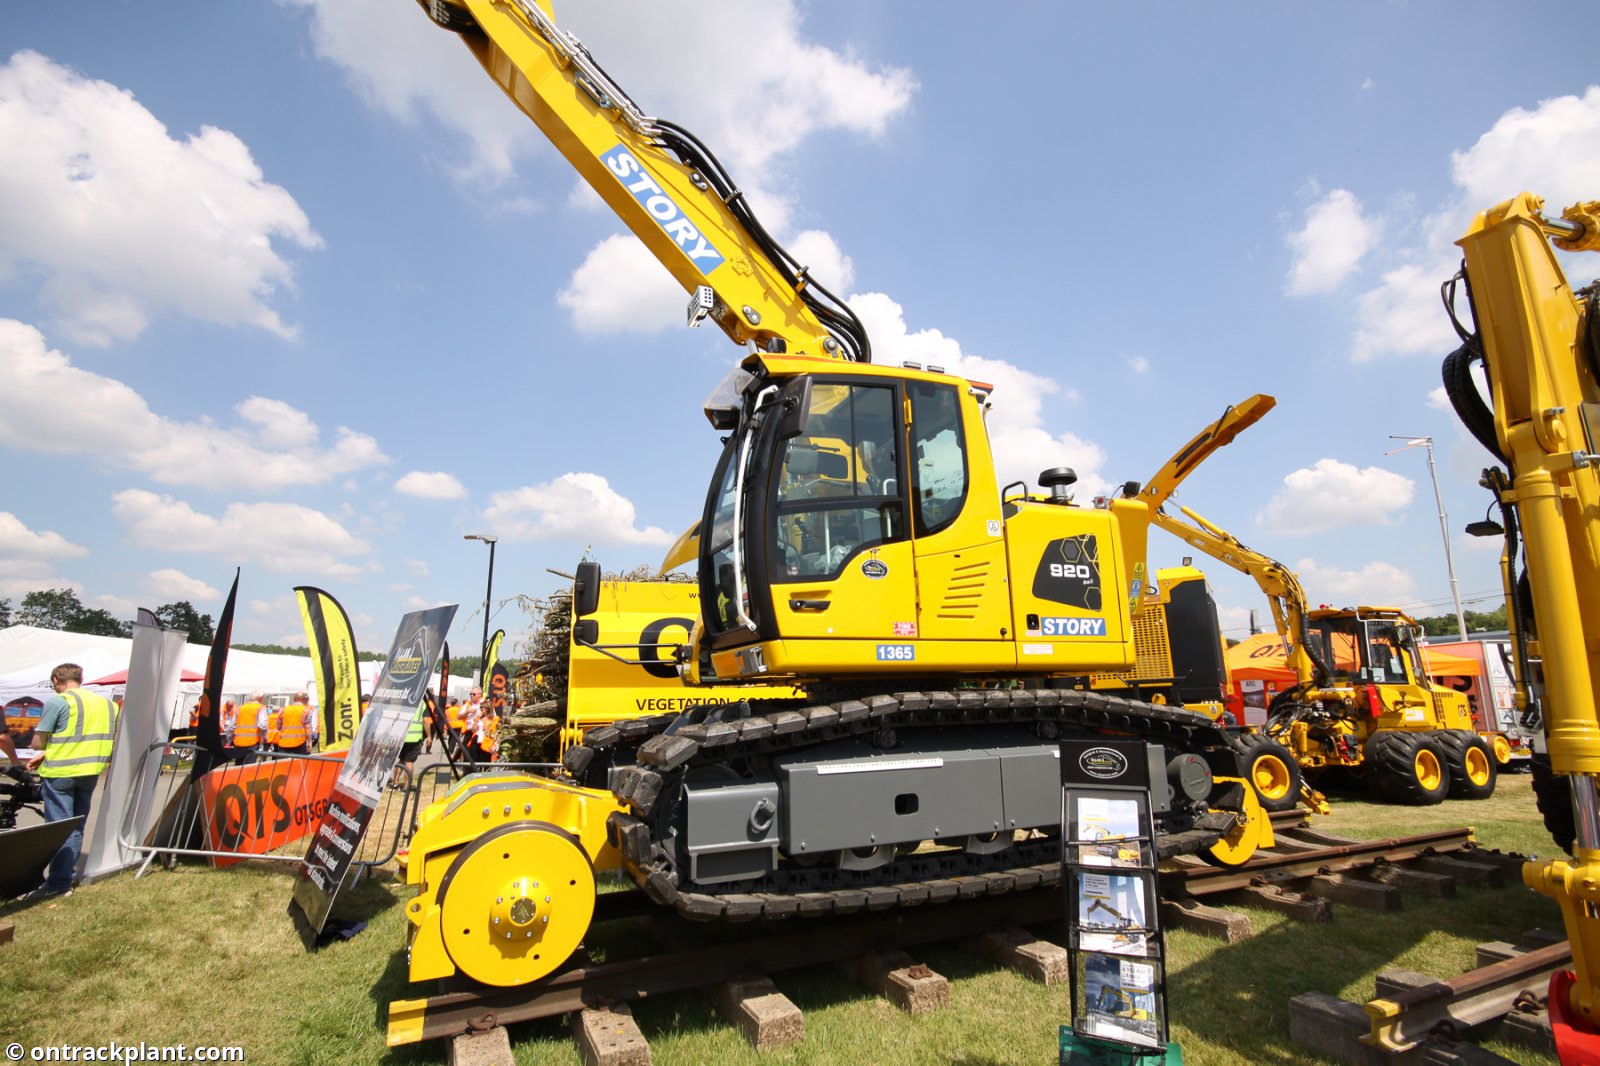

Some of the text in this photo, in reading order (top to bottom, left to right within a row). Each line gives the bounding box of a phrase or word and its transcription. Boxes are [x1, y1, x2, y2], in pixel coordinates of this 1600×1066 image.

[606, 152, 720, 260] STORY
[1049, 563, 1090, 578] 920
[1043, 618, 1103, 635] STORY
[878, 646, 912, 660] 1365
[635, 696, 730, 711] VEGETATION
[337, 697, 354, 742] Zonr.
[215, 774, 291, 850] QTS
